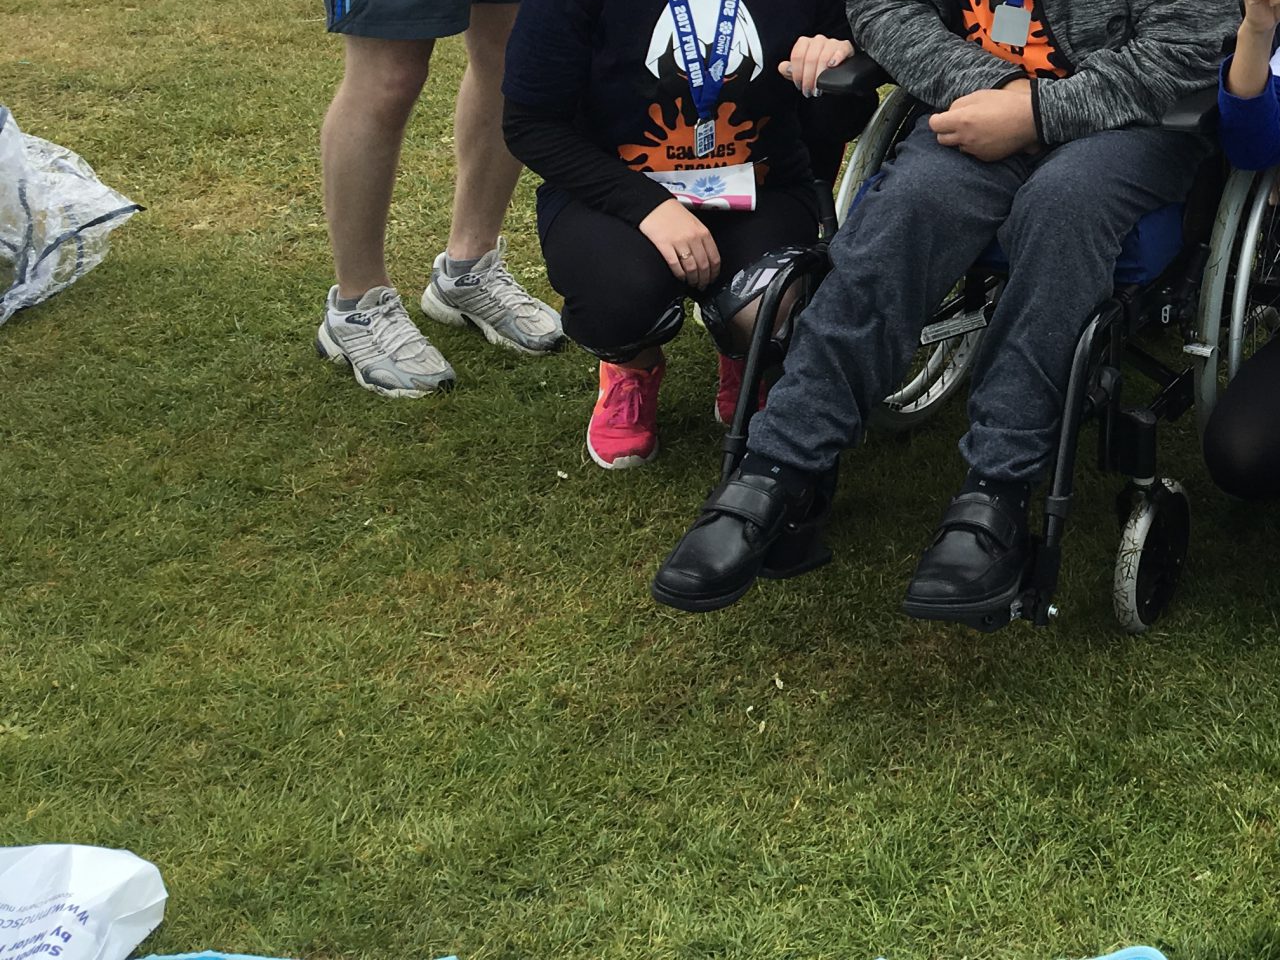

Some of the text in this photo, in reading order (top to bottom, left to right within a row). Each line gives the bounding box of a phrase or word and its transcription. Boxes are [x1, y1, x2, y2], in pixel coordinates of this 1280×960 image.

[674, 5, 690, 33] 2017
[682, 33, 698, 60] FUN
[715, 34, 726, 55] MND
[686, 60, 704, 88] RUN
[49, 925, 72, 943] by
